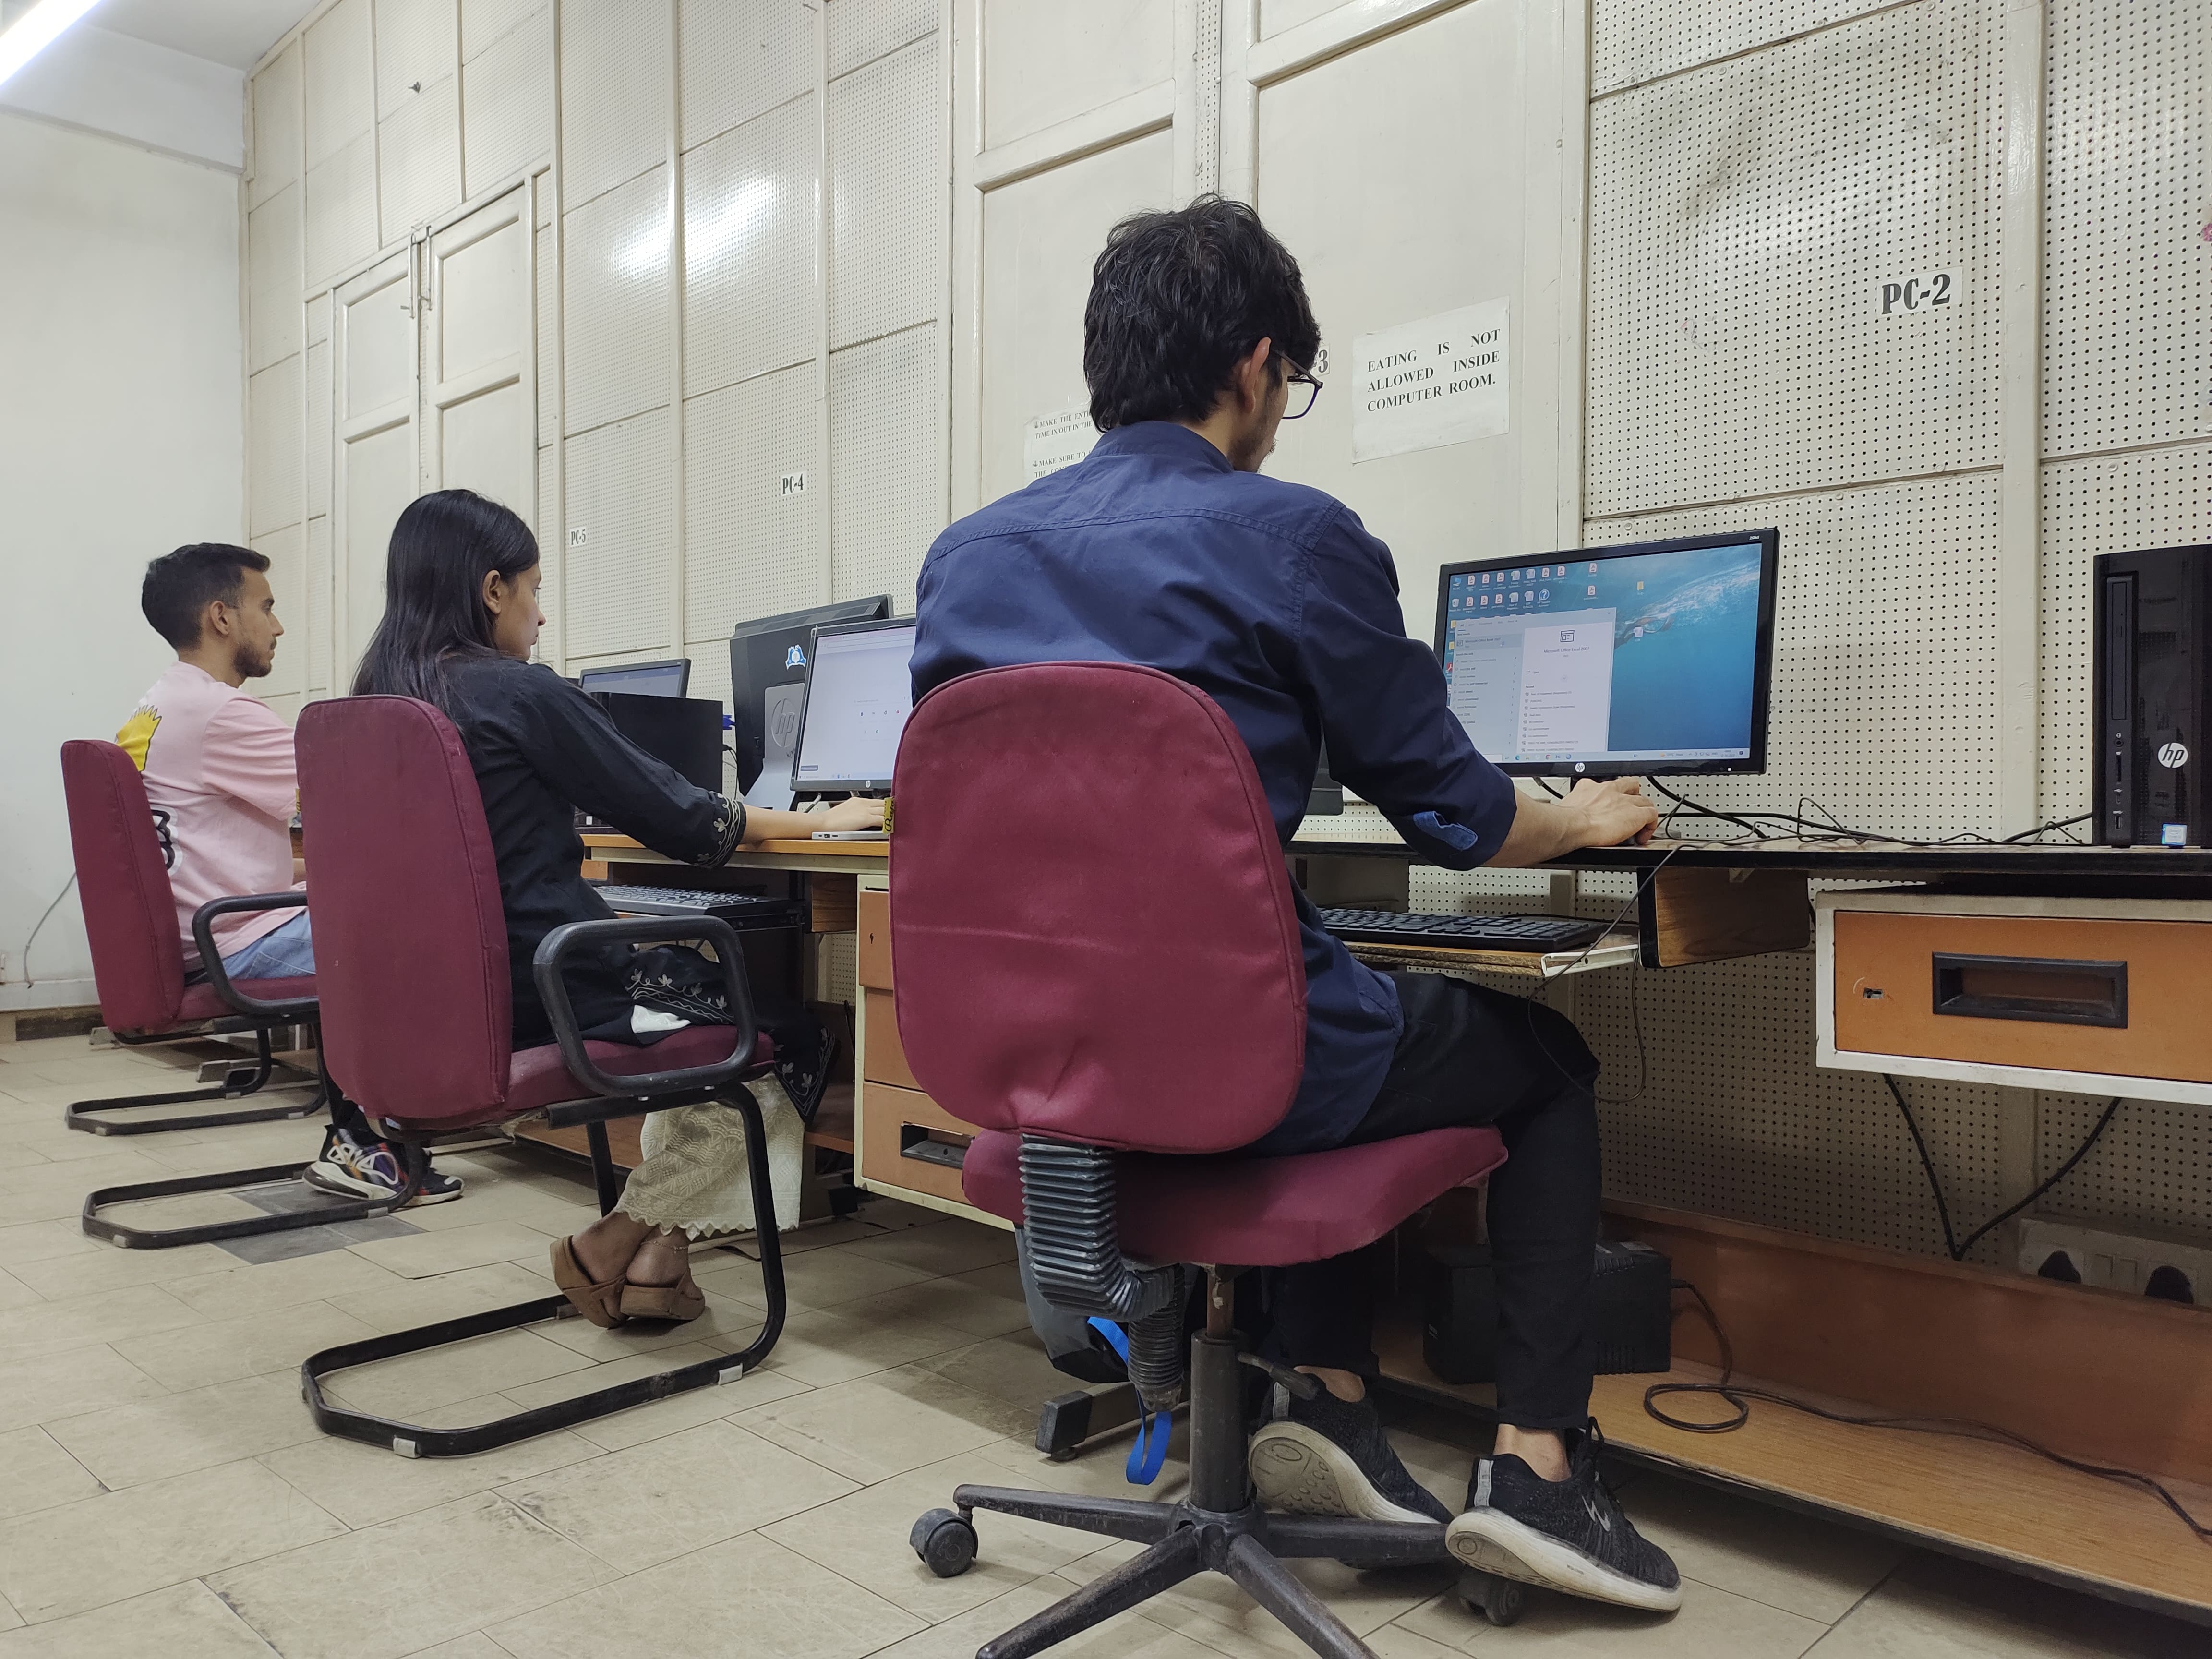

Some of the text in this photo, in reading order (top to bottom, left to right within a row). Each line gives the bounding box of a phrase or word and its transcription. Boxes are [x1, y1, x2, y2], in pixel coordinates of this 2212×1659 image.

[1882, 274, 1950, 315] PC-2
[1368, 329, 1500, 372] EATING IS NOT
[1367, 350, 1500, 392] ALLOWED INSIDE
[1367, 373, 1496, 412] COMPUTER ROOM.
[1035, 430, 1050, 439] TIME
[1051, 425, 1071, 435] IN/OUT
[1081, 421, 1093, 429] THE
[1040, 418, 1057, 428] MAKE
[1060, 415, 1072, 423] THE
[1039, 457, 1057, 467] MAKE
[1059, 454, 1074, 463] SURE
[782, 473, 804, 495] PC-4
[571, 529, 586, 545] PC-5
[2162, 743, 2185, 768] hp
